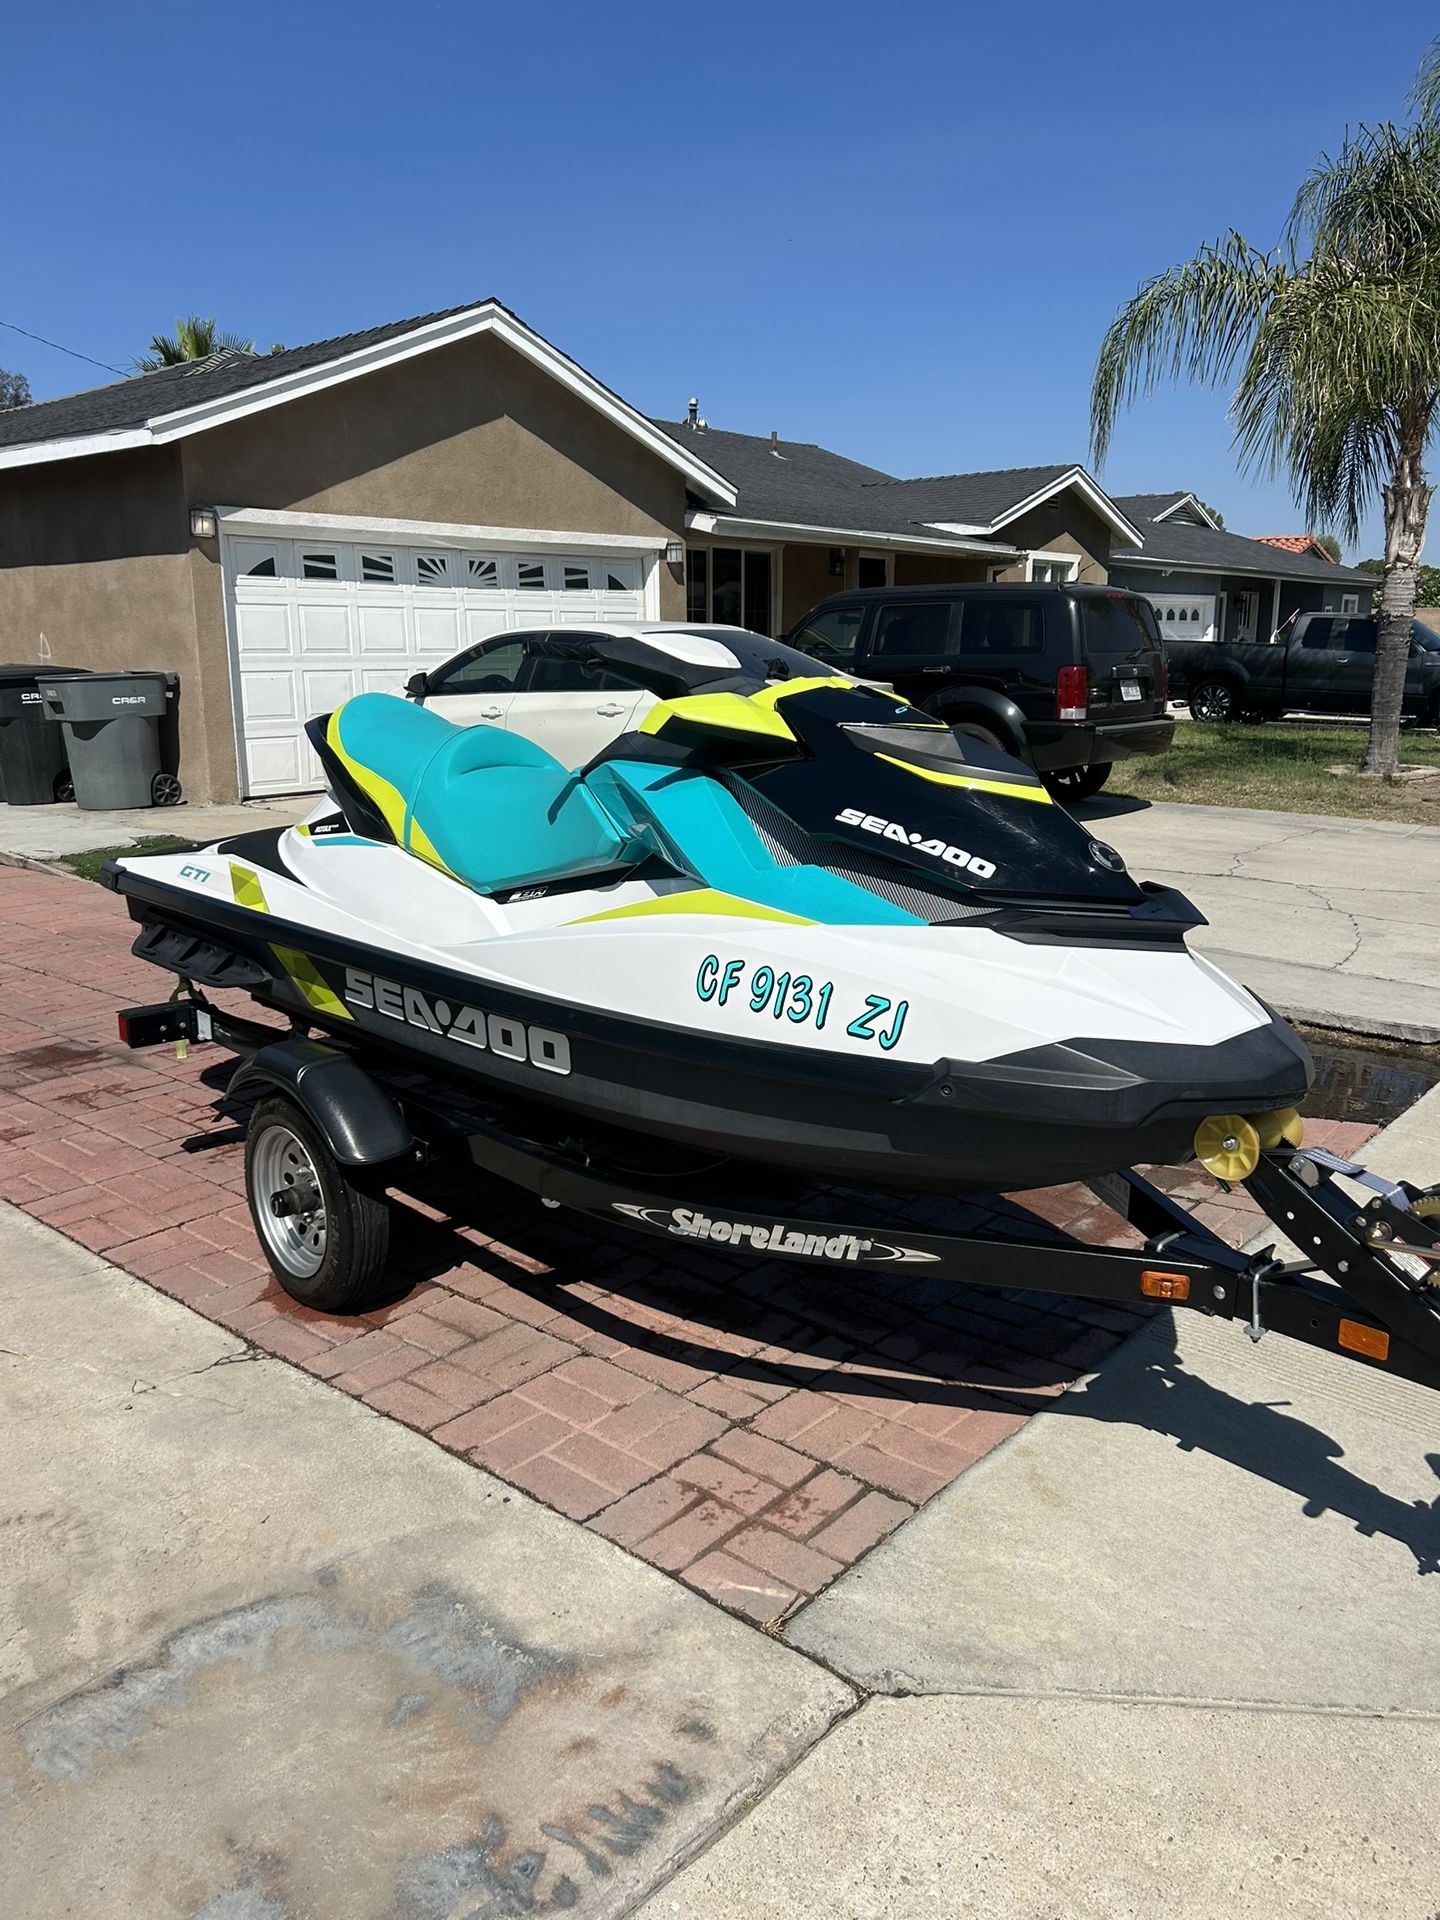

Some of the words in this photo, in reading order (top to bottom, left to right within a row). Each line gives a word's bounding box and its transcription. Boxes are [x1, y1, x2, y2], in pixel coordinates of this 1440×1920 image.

[180, 865, 211, 883] GTI
[696, 954, 745, 1006] CF
[749, 965, 834, 1030] 9131
[847, 994, 909, 1050] ZJ
